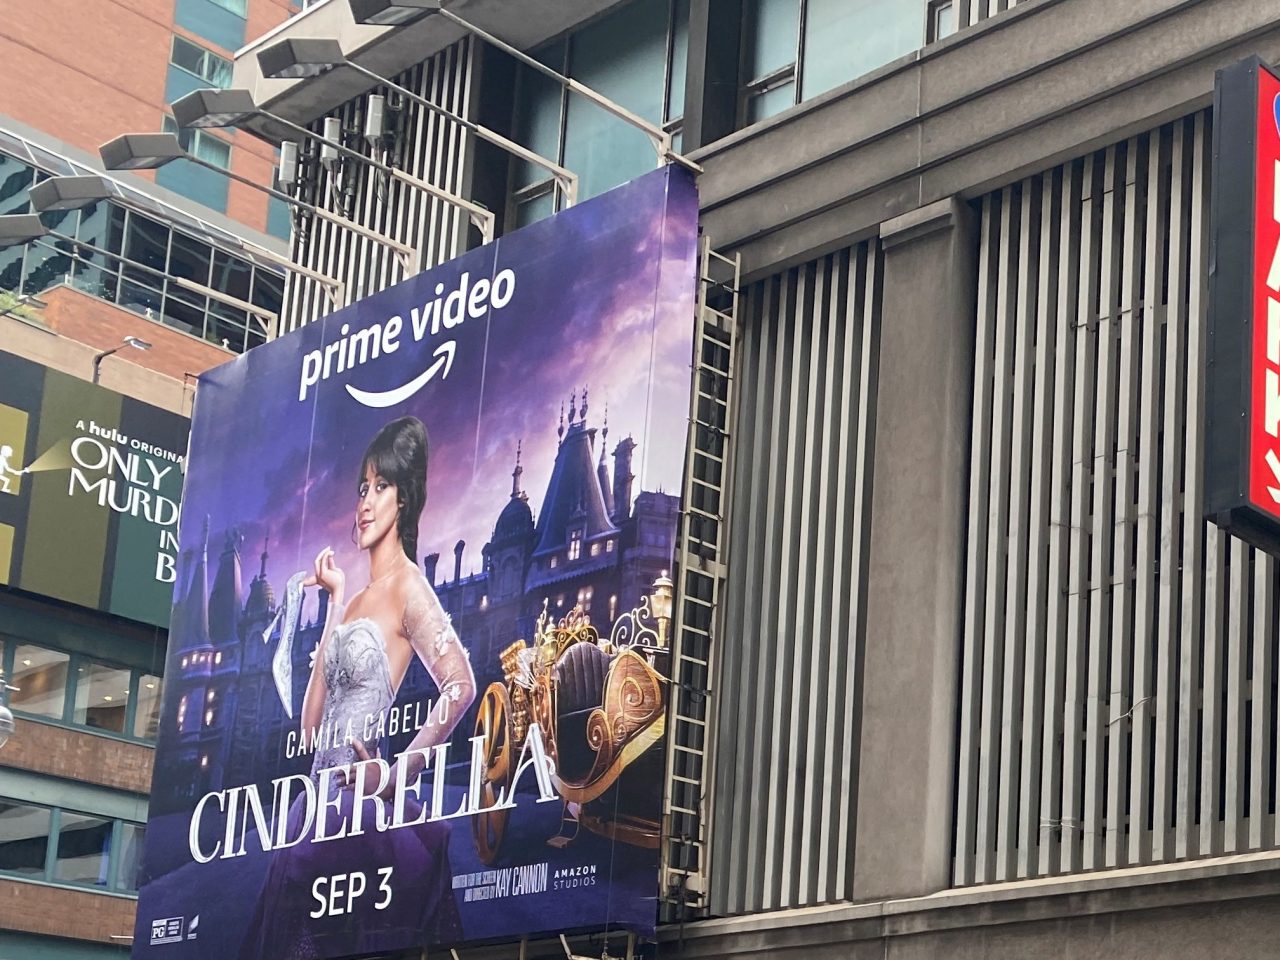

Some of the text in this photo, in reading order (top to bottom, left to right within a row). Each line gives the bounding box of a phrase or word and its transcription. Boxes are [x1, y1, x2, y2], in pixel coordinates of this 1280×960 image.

[299, 269, 516, 401] prime video
[71, 437, 172, 490] ONLY
[76, 420, 184, 464] A hulu ORIGINA
[69, 467, 180, 525] MURD
[160, 530, 180, 552] IN
[155, 552, 177, 582] B
[285, 697, 449, 758] CAMILA CABELLO
[188, 723, 560, 864] CINDERELLA
[310, 867, 394, 918] SEP 3
[495, 868, 512, 899] KAY
[512, 862, 549, 896] CANNON
[554, 865, 596, 879] AMAZON
[554, 876, 596, 890] STUDIOS
[152, 927, 165, 939] PG
